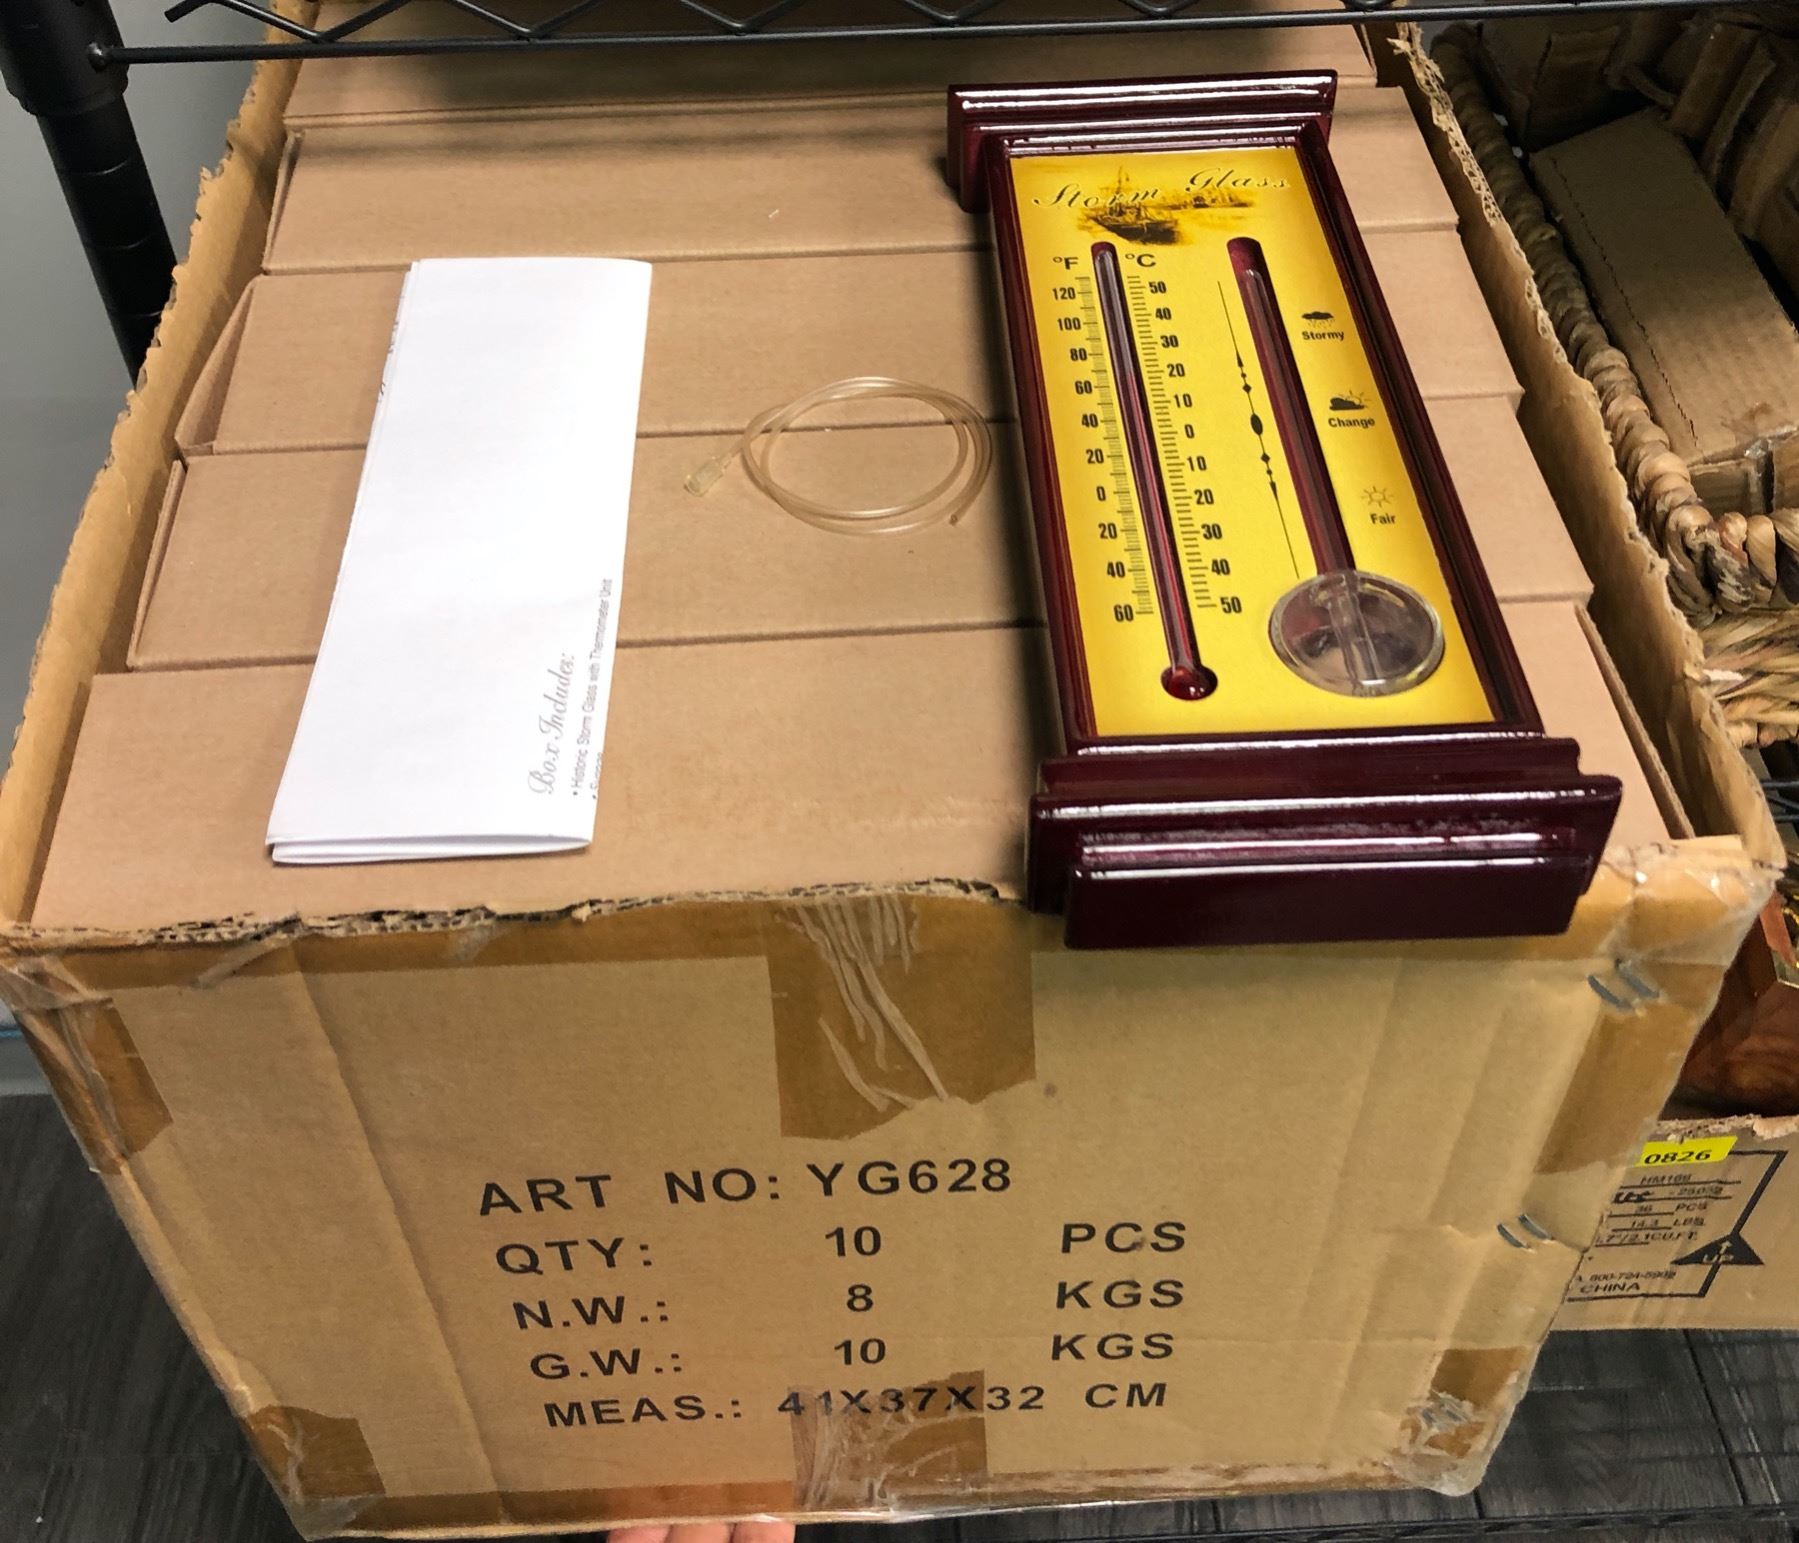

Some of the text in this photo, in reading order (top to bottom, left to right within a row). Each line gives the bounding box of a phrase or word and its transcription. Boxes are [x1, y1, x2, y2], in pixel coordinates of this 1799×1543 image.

[1033, 168, 1292, 208] Storm Glass
[1052, 287, 1076, 300] 120
[1148, 281, 1167, 294] 50
[1154, 308, 1173, 320] 40
[1057, 317, 1082, 331] 100
[1160, 335, 1179, 348] 30
[1302, 329, 1345, 342] Stormy
[1070, 348, 1087, 361] 80
[1166, 363, 1186, 377] 20
[1075, 380, 1093, 394] 60
[1173, 394, 1193, 408] 10
[1081, 413, 1098, 428] 40
[1328, 416, 1375, 429] Change
[1184, 424, 1195, 438] 0
[1086, 449, 1104, 464] 20
[1188, 456, 1207, 471] 10
[1096, 486, 1106, 501] 0
[1194, 489, 1214, 505] 20
[1370, 513, 1396, 525] Fair
[1098, 523, 1117, 539] 20
[1201, 524, 1223, 540] 30
[1106, 562, 1126, 578] 40
[1210, 559, 1230, 575] 40
[599, 578, 612, 599] Unit
[1220, 597, 1242, 614] 50
[1113, 605, 1134, 622] 60
[589, 598, 610, 660] Thermometer
[589, 663, 600, 681] with
[582, 684, 598, 713] Glass
[527, 653, 575, 795] Box Includes:
[577, 715, 593, 746] Storm
[1643, 1150, 1712, 1165] 0826
[479, 1158, 1012, 1217] ART NO: YG628
[1675, 1202, 1708, 1212] PCS
[495, 1221, 1188, 1276] QTY: 10 PCS
[1703, 1253, 1735, 1264] UP
[1580, 1282, 1641, 1293] CHINA
[846, 1284, 874, 1313] 8
[1055, 1279, 1185, 1310] KGS
[833, 1338, 886, 1367] 10
[1050, 1333, 1175, 1362] KGS
[777, 1384, 1045, 1416] 41X37X32
[1084, 1382, 1168, 1409] CM
